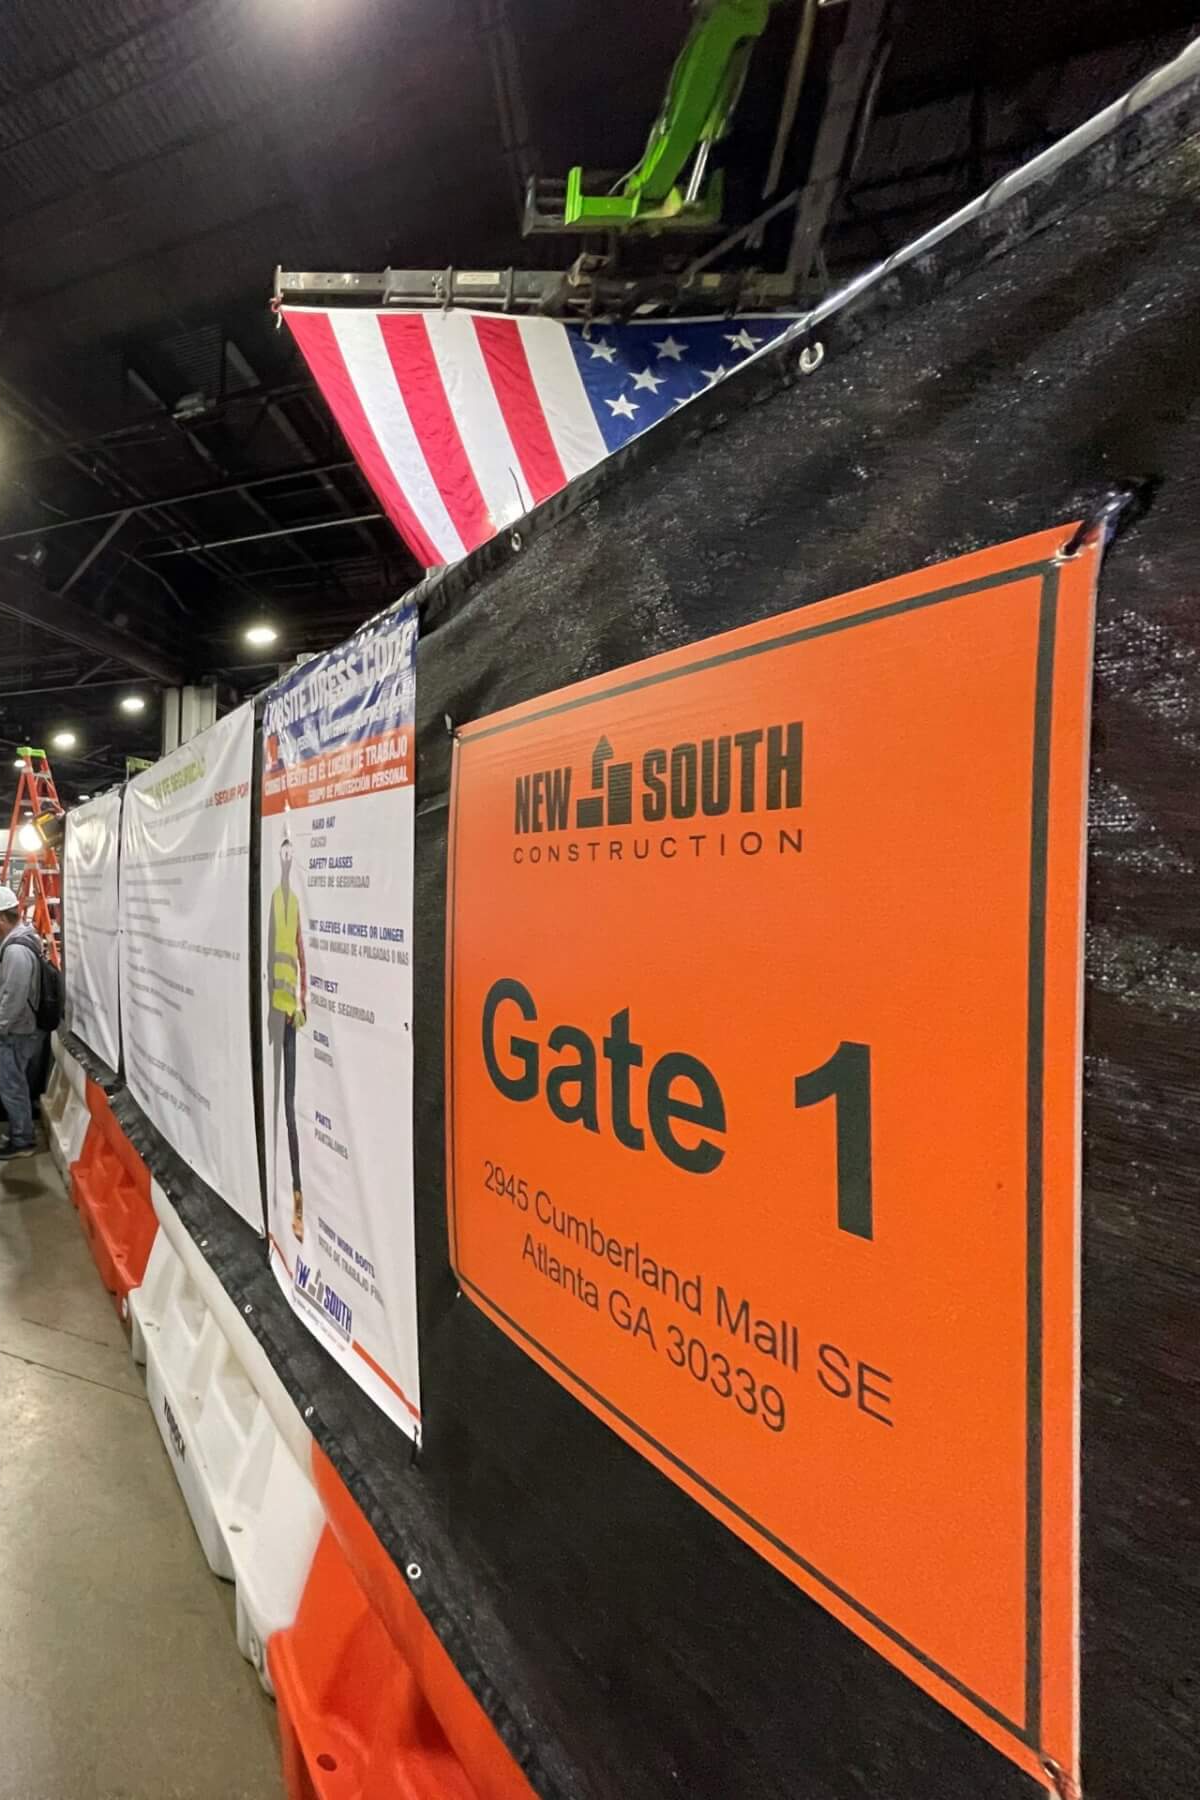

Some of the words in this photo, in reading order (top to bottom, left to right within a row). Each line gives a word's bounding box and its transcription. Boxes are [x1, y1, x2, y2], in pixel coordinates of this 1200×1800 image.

[310, 654, 358, 713] DRESS
[328, 753, 351, 779] LUGAR
[353, 750, 365, 770] DE
[366, 735, 408, 766] TRABAJO
[371, 765, 408, 788] PERSONAL
[515, 767, 572, 834] NEW
[642, 721, 803, 822] SOUTH
[308, 857, 327, 869] SAFETY
[328, 856, 353, 869] GLASSES
[513, 829, 803, 863] CONSTRUCTION
[327, 875, 335, 888] DE
[336, 875, 370, 889] SEGURIDAD
[319, 920, 341, 934] SLEEVES
[347, 923, 368, 938] INCHES
[369, 926, 378, 939] OR
[379, 926, 405, 943] LONGER
[351, 943, 358, 957] DE
[337, 1001, 375, 1024] SEGURIDAD
[482, 978, 727, 1174] Gate
[794, 1040, 874, 1242] 1
[355, 1250, 375, 1279] BOOTS
[324, 1284, 353, 1334] SOUTH
[484, 1160, 529, 1211] 2945
[535, 1191, 702, 1315] Cumberland
[716, 1286, 798, 1372] Mall
[816, 1343, 894, 1428] SE
[522, 1233, 599, 1312] Atlanta
[609, 1289, 658, 1351] GA
[667, 1324, 786, 1433] 30339
